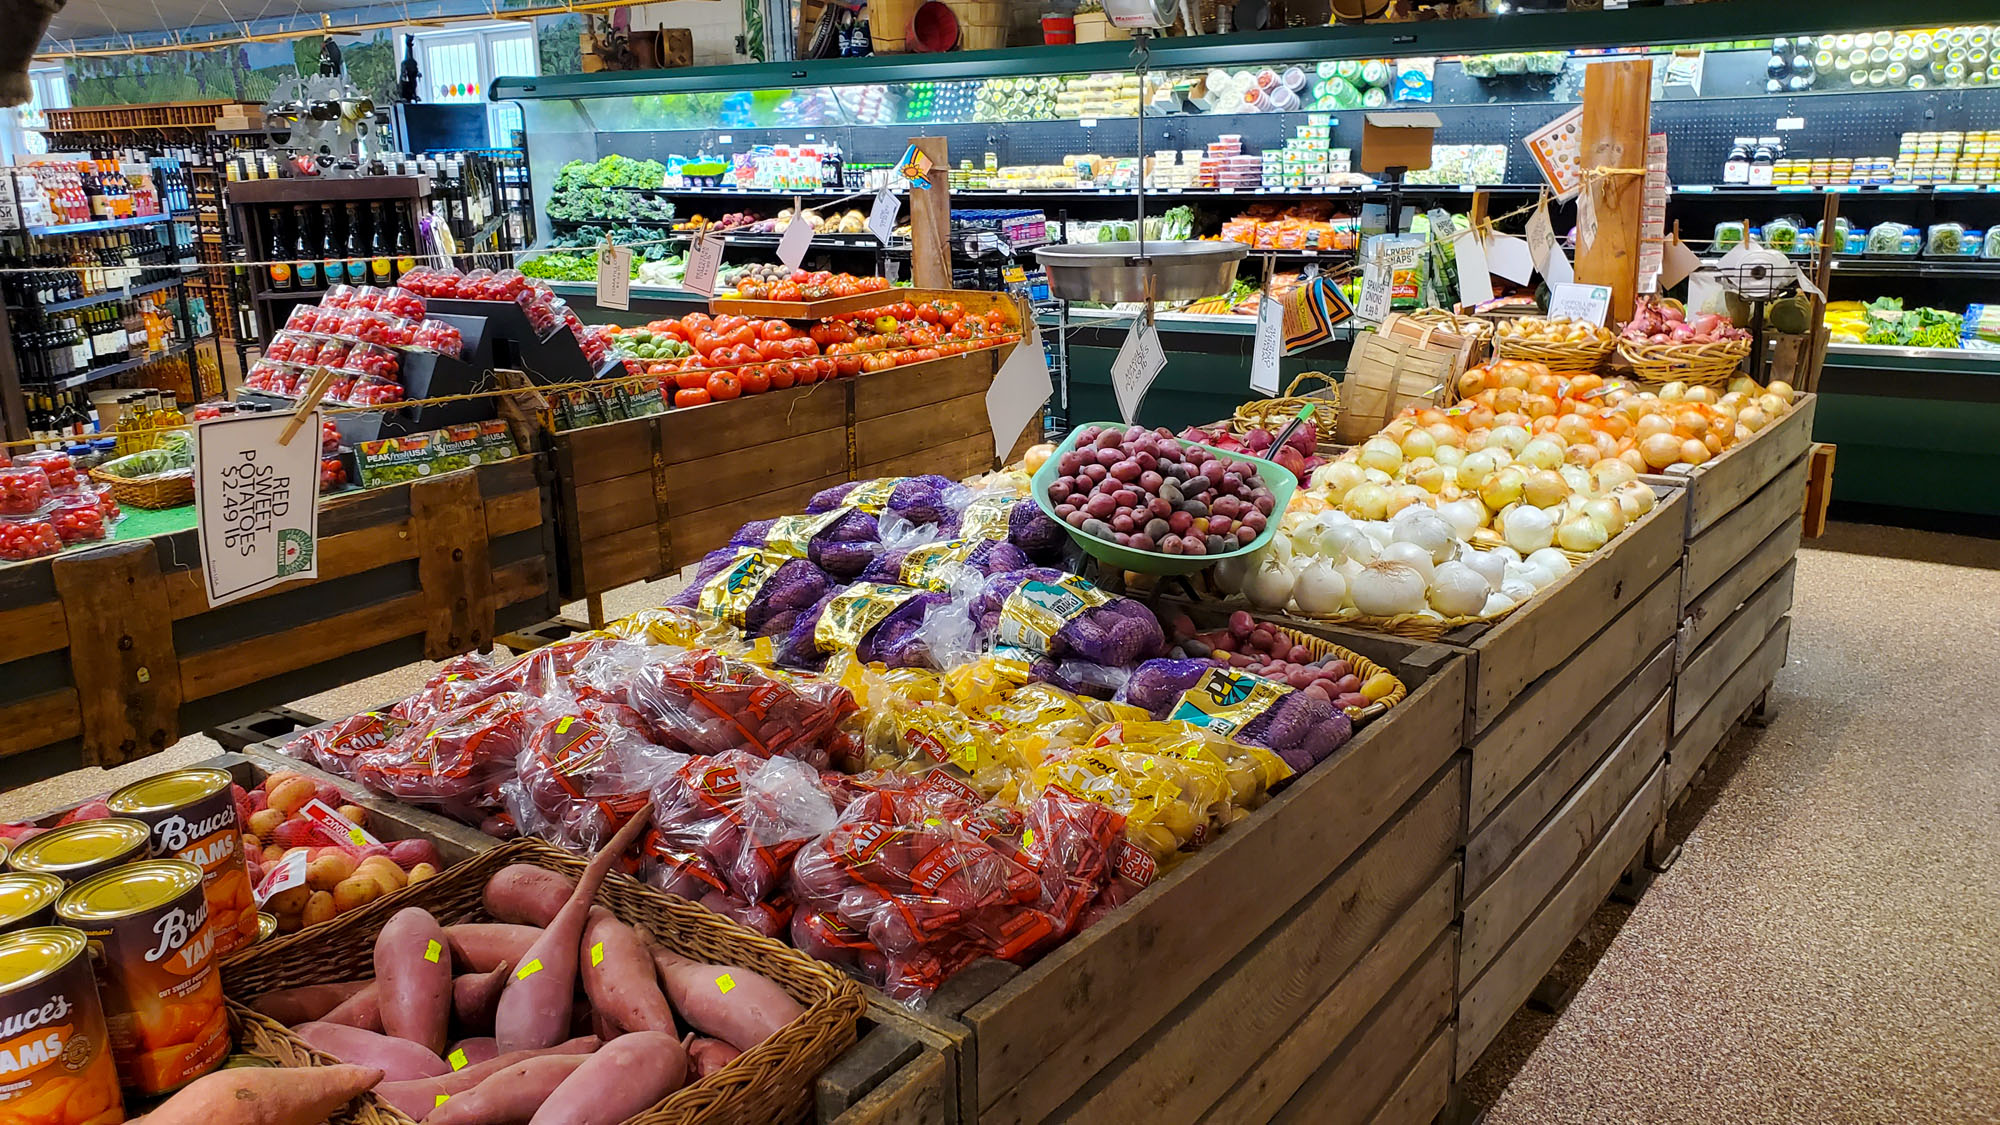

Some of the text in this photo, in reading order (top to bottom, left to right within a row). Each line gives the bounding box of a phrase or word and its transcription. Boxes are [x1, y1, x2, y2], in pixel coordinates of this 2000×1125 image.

[1365, 291, 1383, 305] ONIONS
[1126, 344, 1149, 391] POTATOES
[461, 439, 477, 448] USA
[491, 432, 506, 442] USA
[409, 448, 427, 458] USA
[371, 478, 381, 486] 10
[221, 465, 240, 548] $2.49 lb
[239, 449, 256, 557] POTATOES
[255, 465, 273, 533] SWEET
[272, 477, 290, 517] RED
[1054, 594, 1081, 615] IDAHO
[567, 732, 608, 764] AUN
[936, 772, 966, 797] WADA!
[152, 804, 235, 857] Bruce's
[179, 834, 235, 865] YAMS
[1134, 852, 1150, 868] BE
[1124, 862, 1150, 884] IT'S
[0, 1032, 63, 1075] AMS
